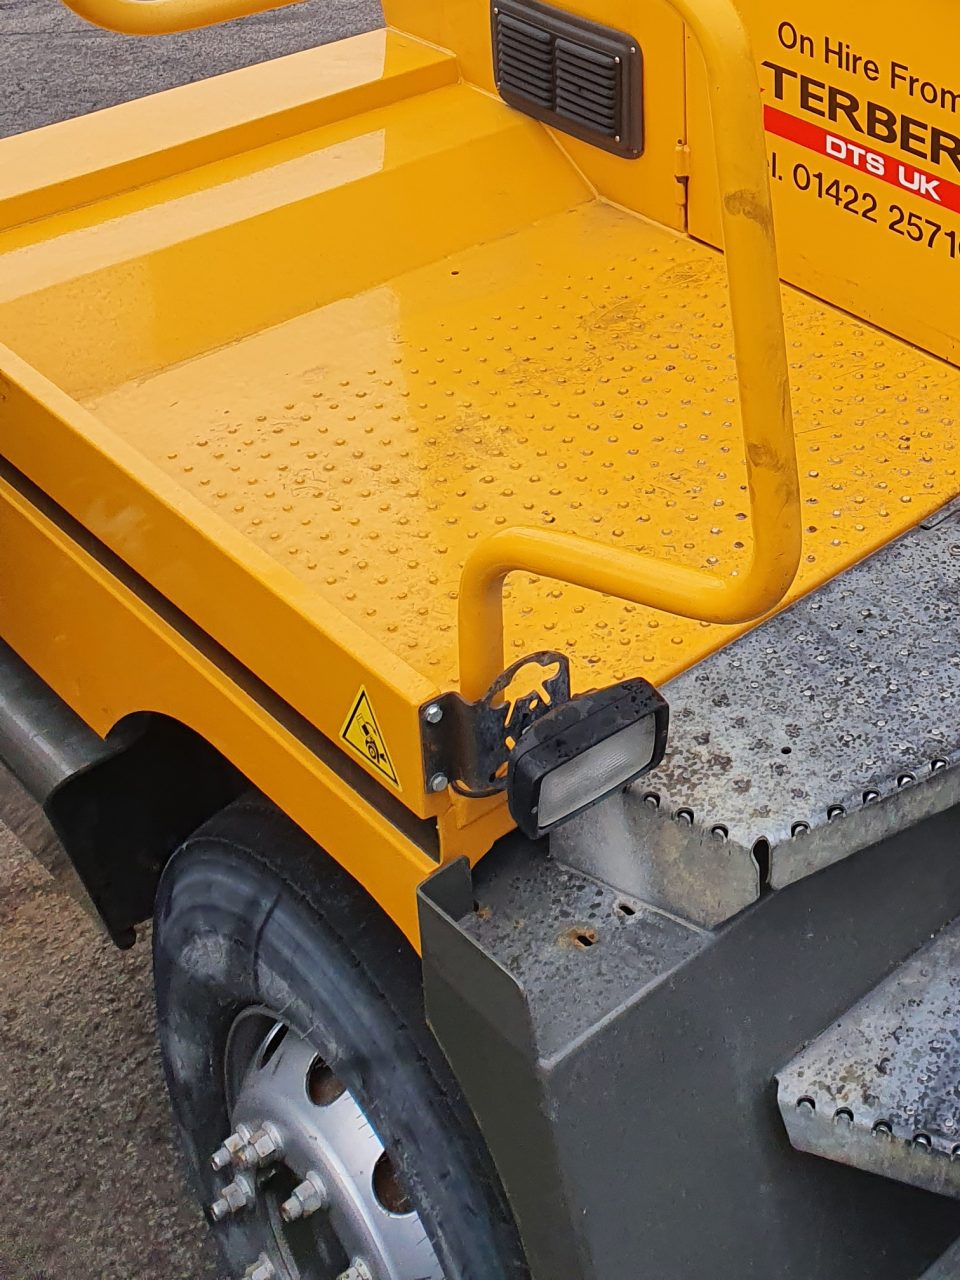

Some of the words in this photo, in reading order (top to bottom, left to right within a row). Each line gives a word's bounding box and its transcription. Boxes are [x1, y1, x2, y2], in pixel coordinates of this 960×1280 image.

[778, 21, 814, 58] On
[824, 36, 880, 81] Hire
[793, 163, 878, 224] 01422
[826, 134, 885, 176] DTS
[898, 165, 941, 201] UK
